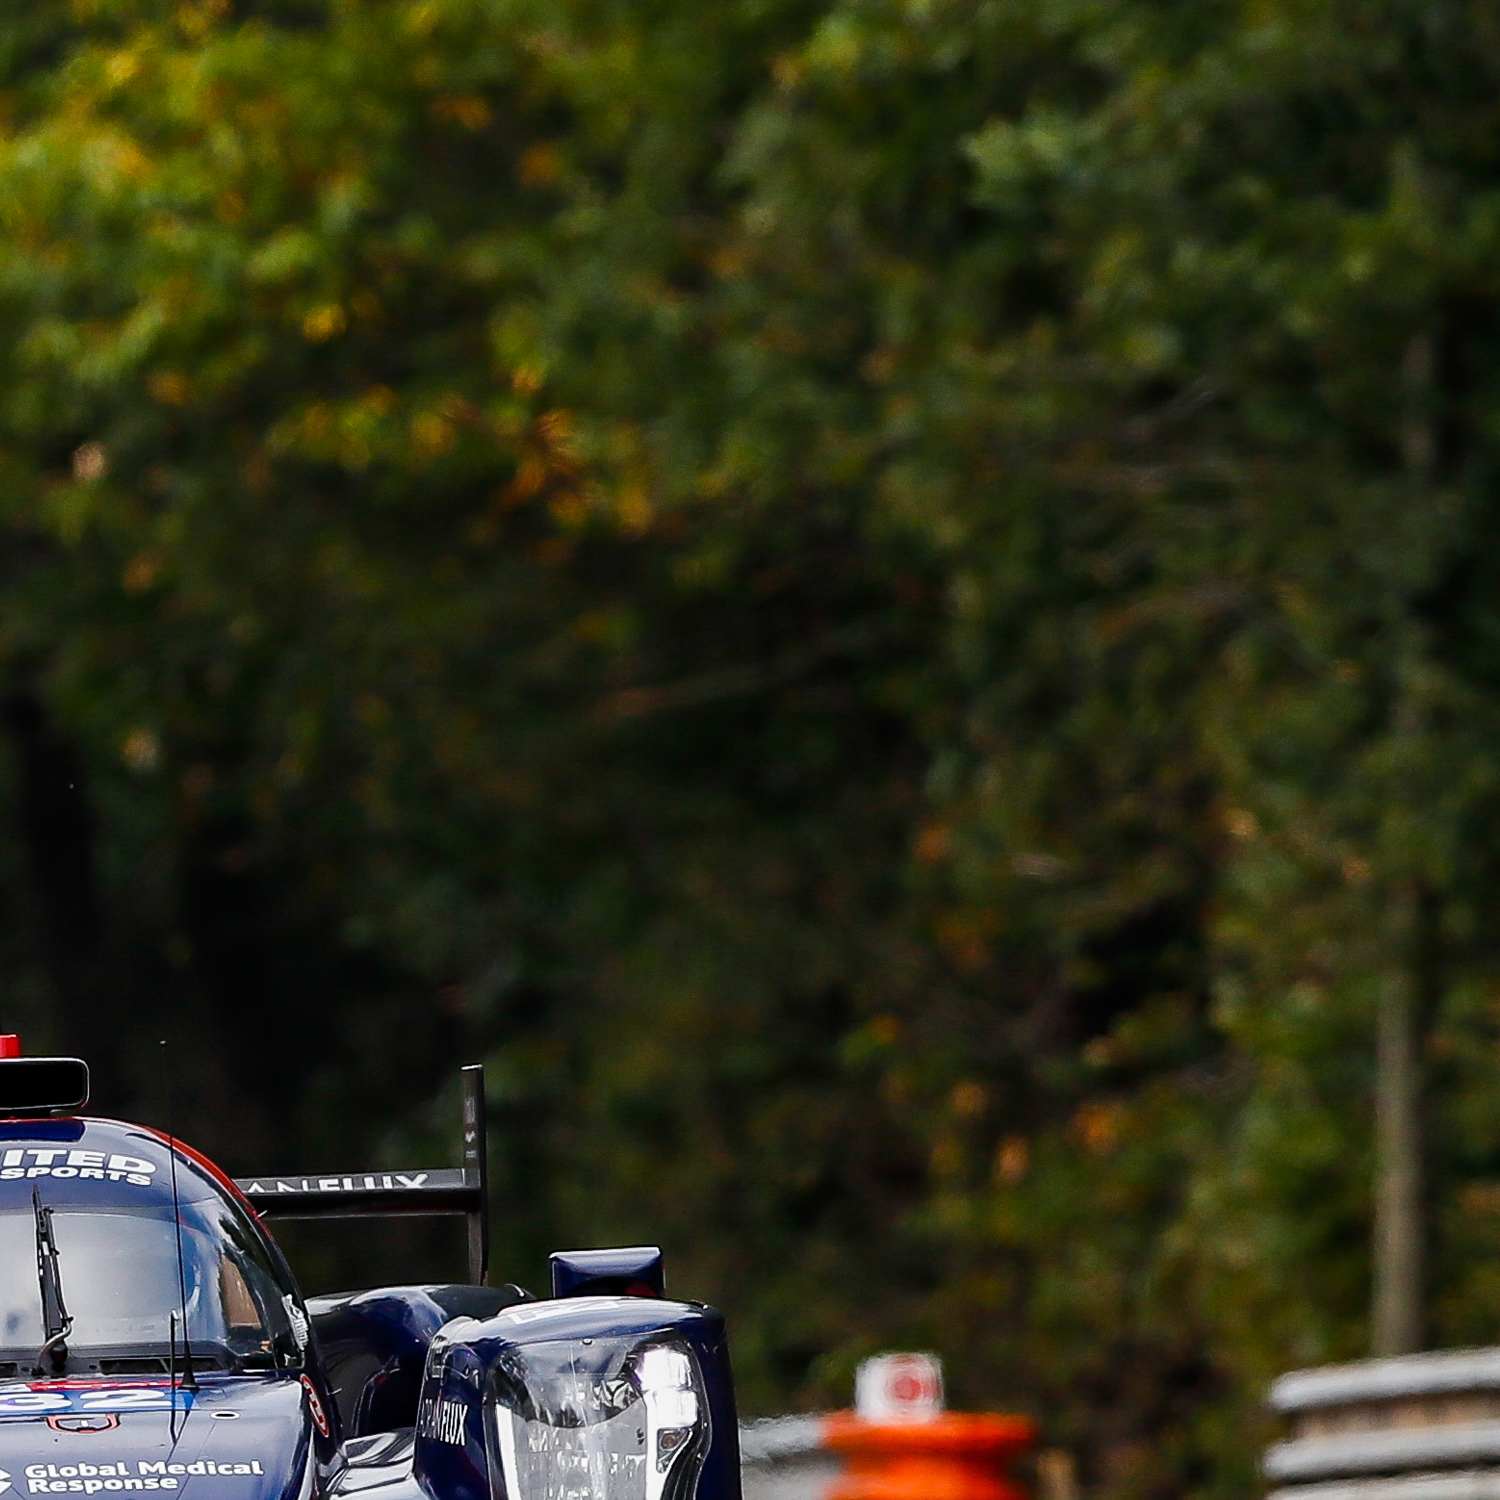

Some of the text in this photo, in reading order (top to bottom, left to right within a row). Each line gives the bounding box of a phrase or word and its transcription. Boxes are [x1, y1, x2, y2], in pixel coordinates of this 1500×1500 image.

[24, 1460, 264, 1479] Global Medical
[28, 1476, 179, 1495] Response
